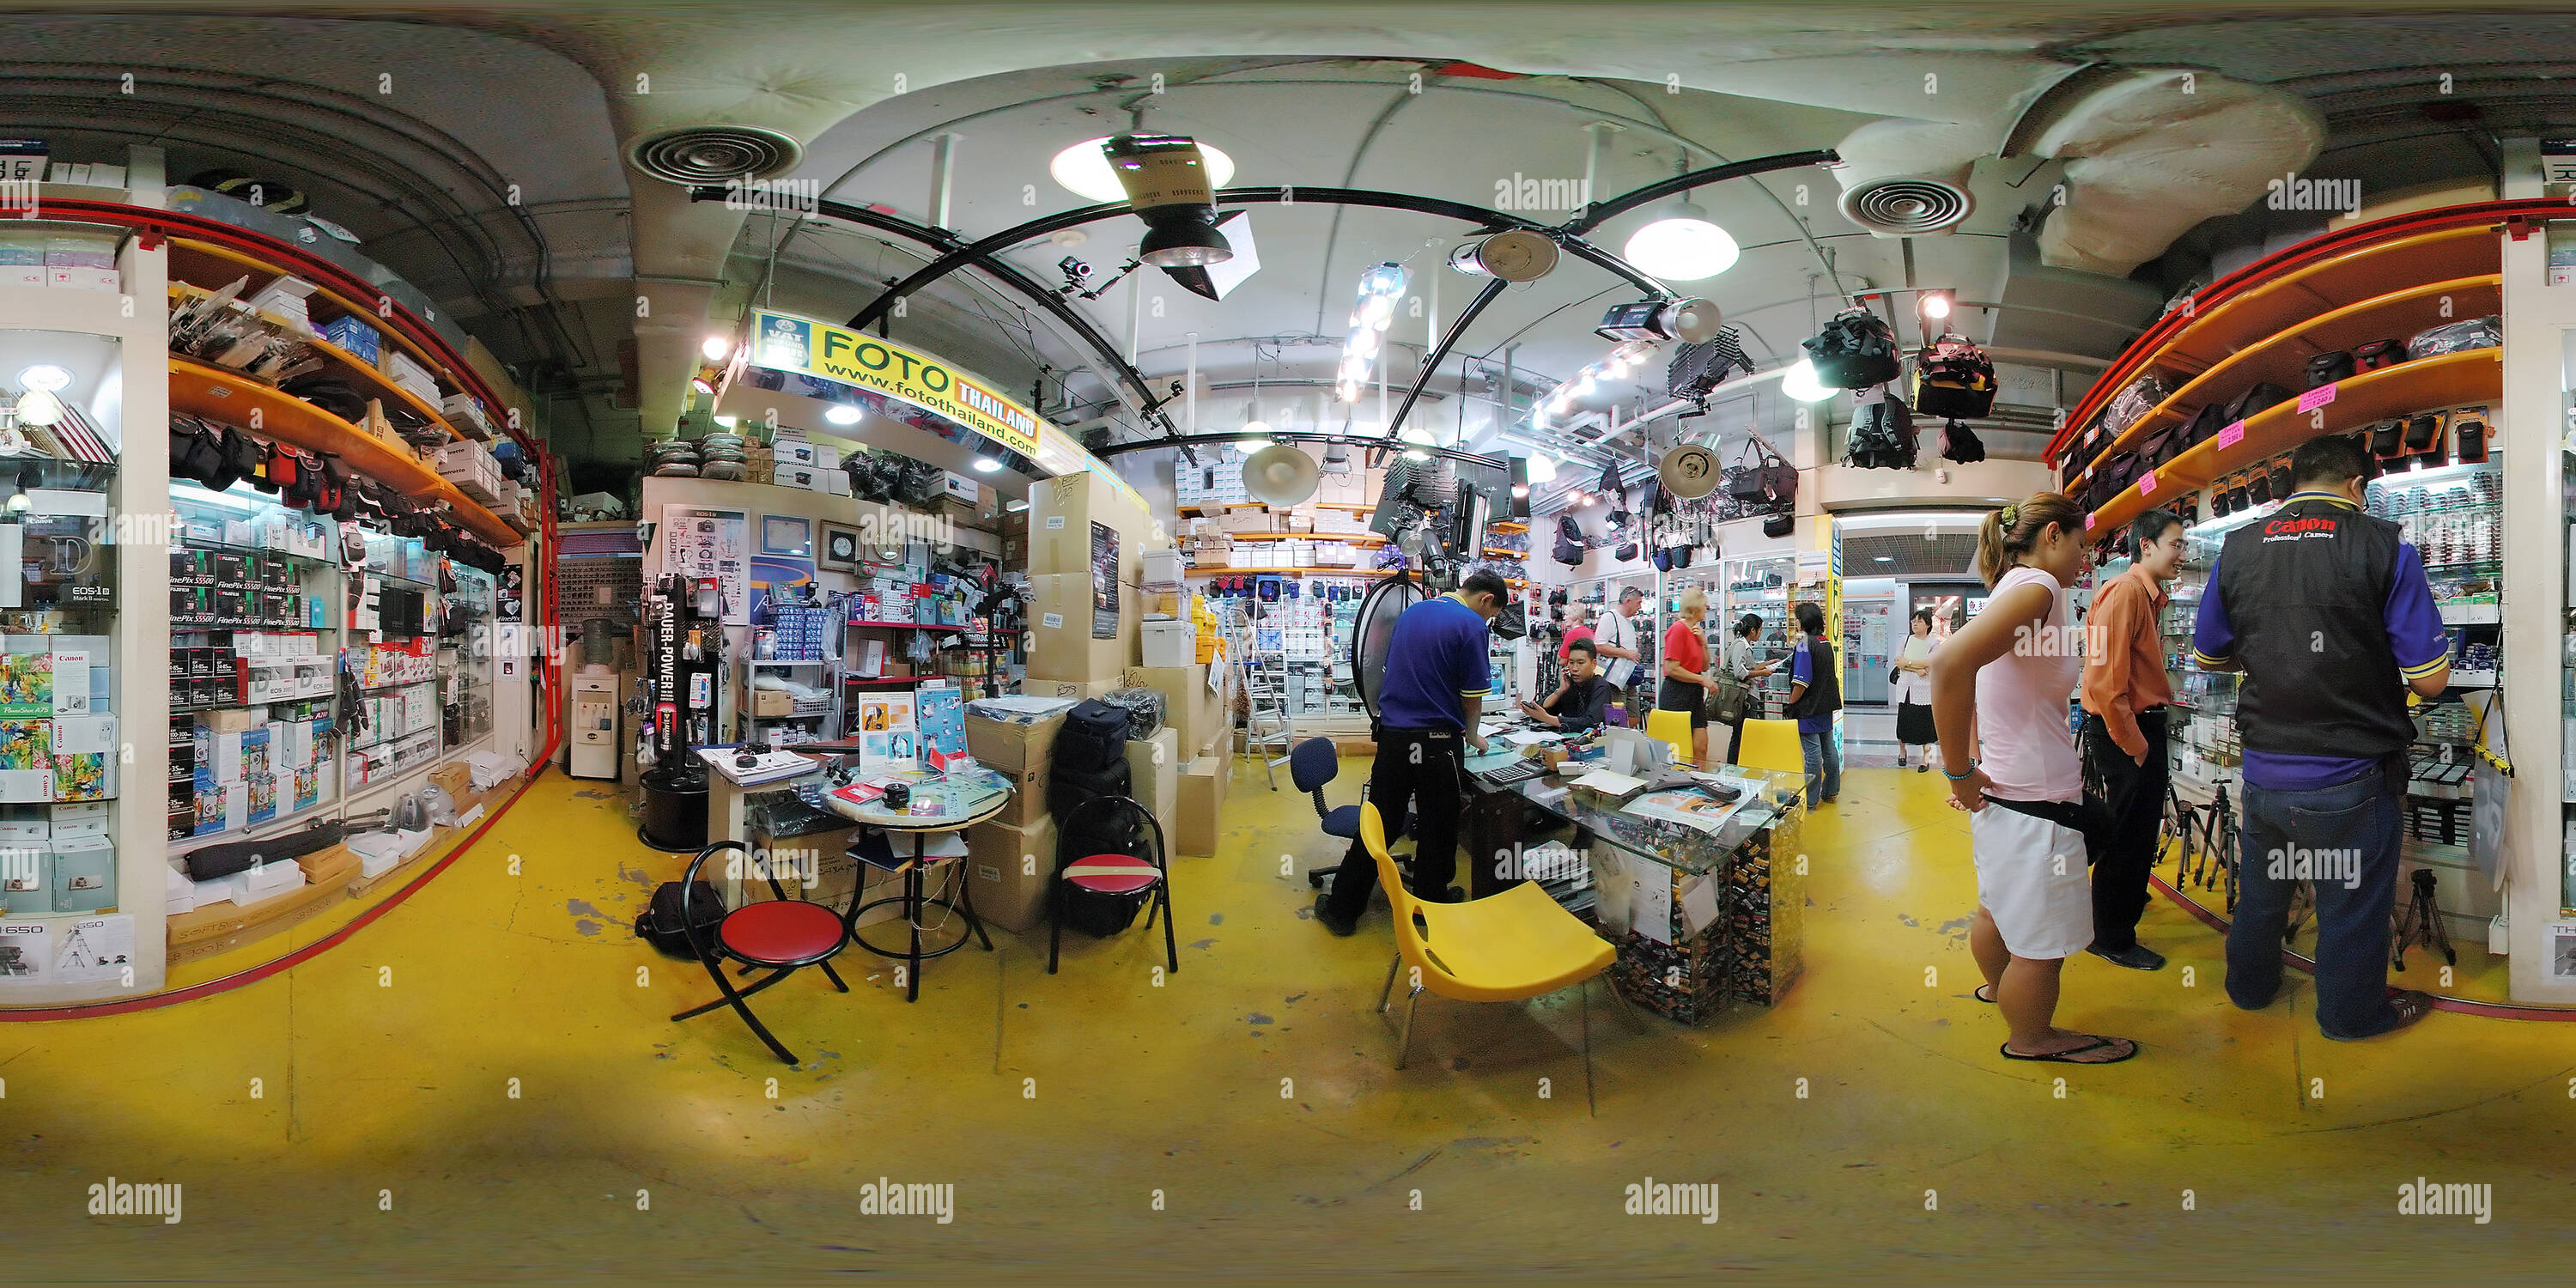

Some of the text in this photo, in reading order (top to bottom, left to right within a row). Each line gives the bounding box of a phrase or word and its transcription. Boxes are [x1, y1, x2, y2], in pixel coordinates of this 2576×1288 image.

[768, 329, 804, 342] VAT
[824, 330, 949, 392] FOTO
[824, 362, 1036, 456] www.fotothailand.com
[958, 381, 1036, 438] THAILAND
[2264, 518, 2336, 534] Canon
[50, 536, 93, 575] D
